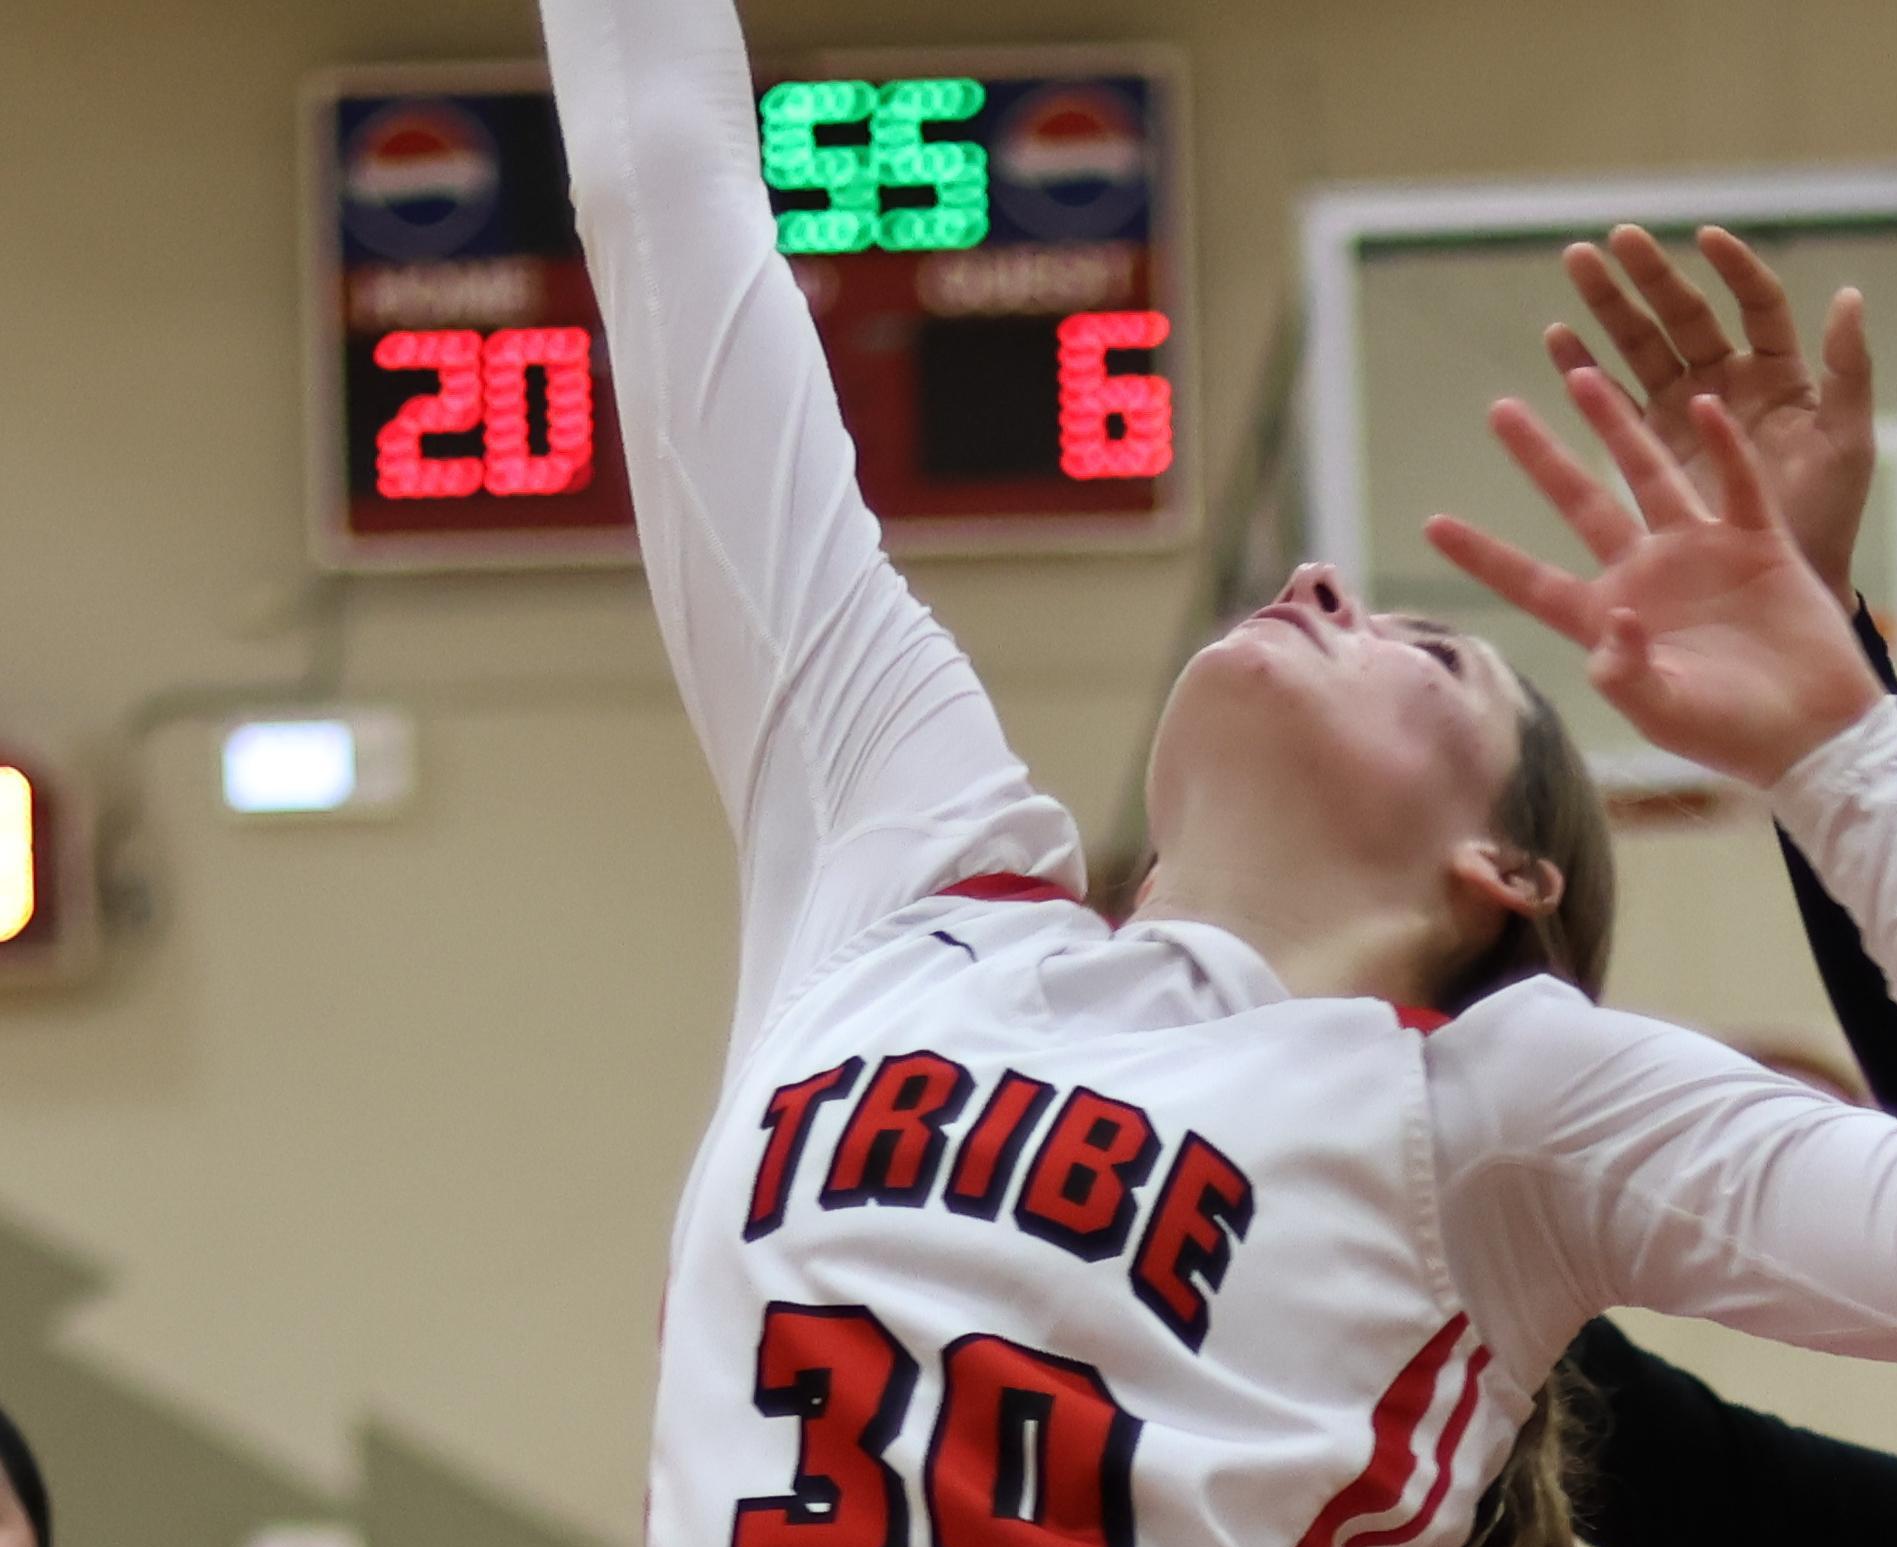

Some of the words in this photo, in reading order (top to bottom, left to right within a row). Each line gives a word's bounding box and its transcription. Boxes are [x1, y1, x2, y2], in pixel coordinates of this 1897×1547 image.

[760, 78, 989, 254] 55
[373, 327, 593, 499] 20
[1056, 311, 1172, 481] 6
[743, 1049, 1255, 1355] TRIBE
